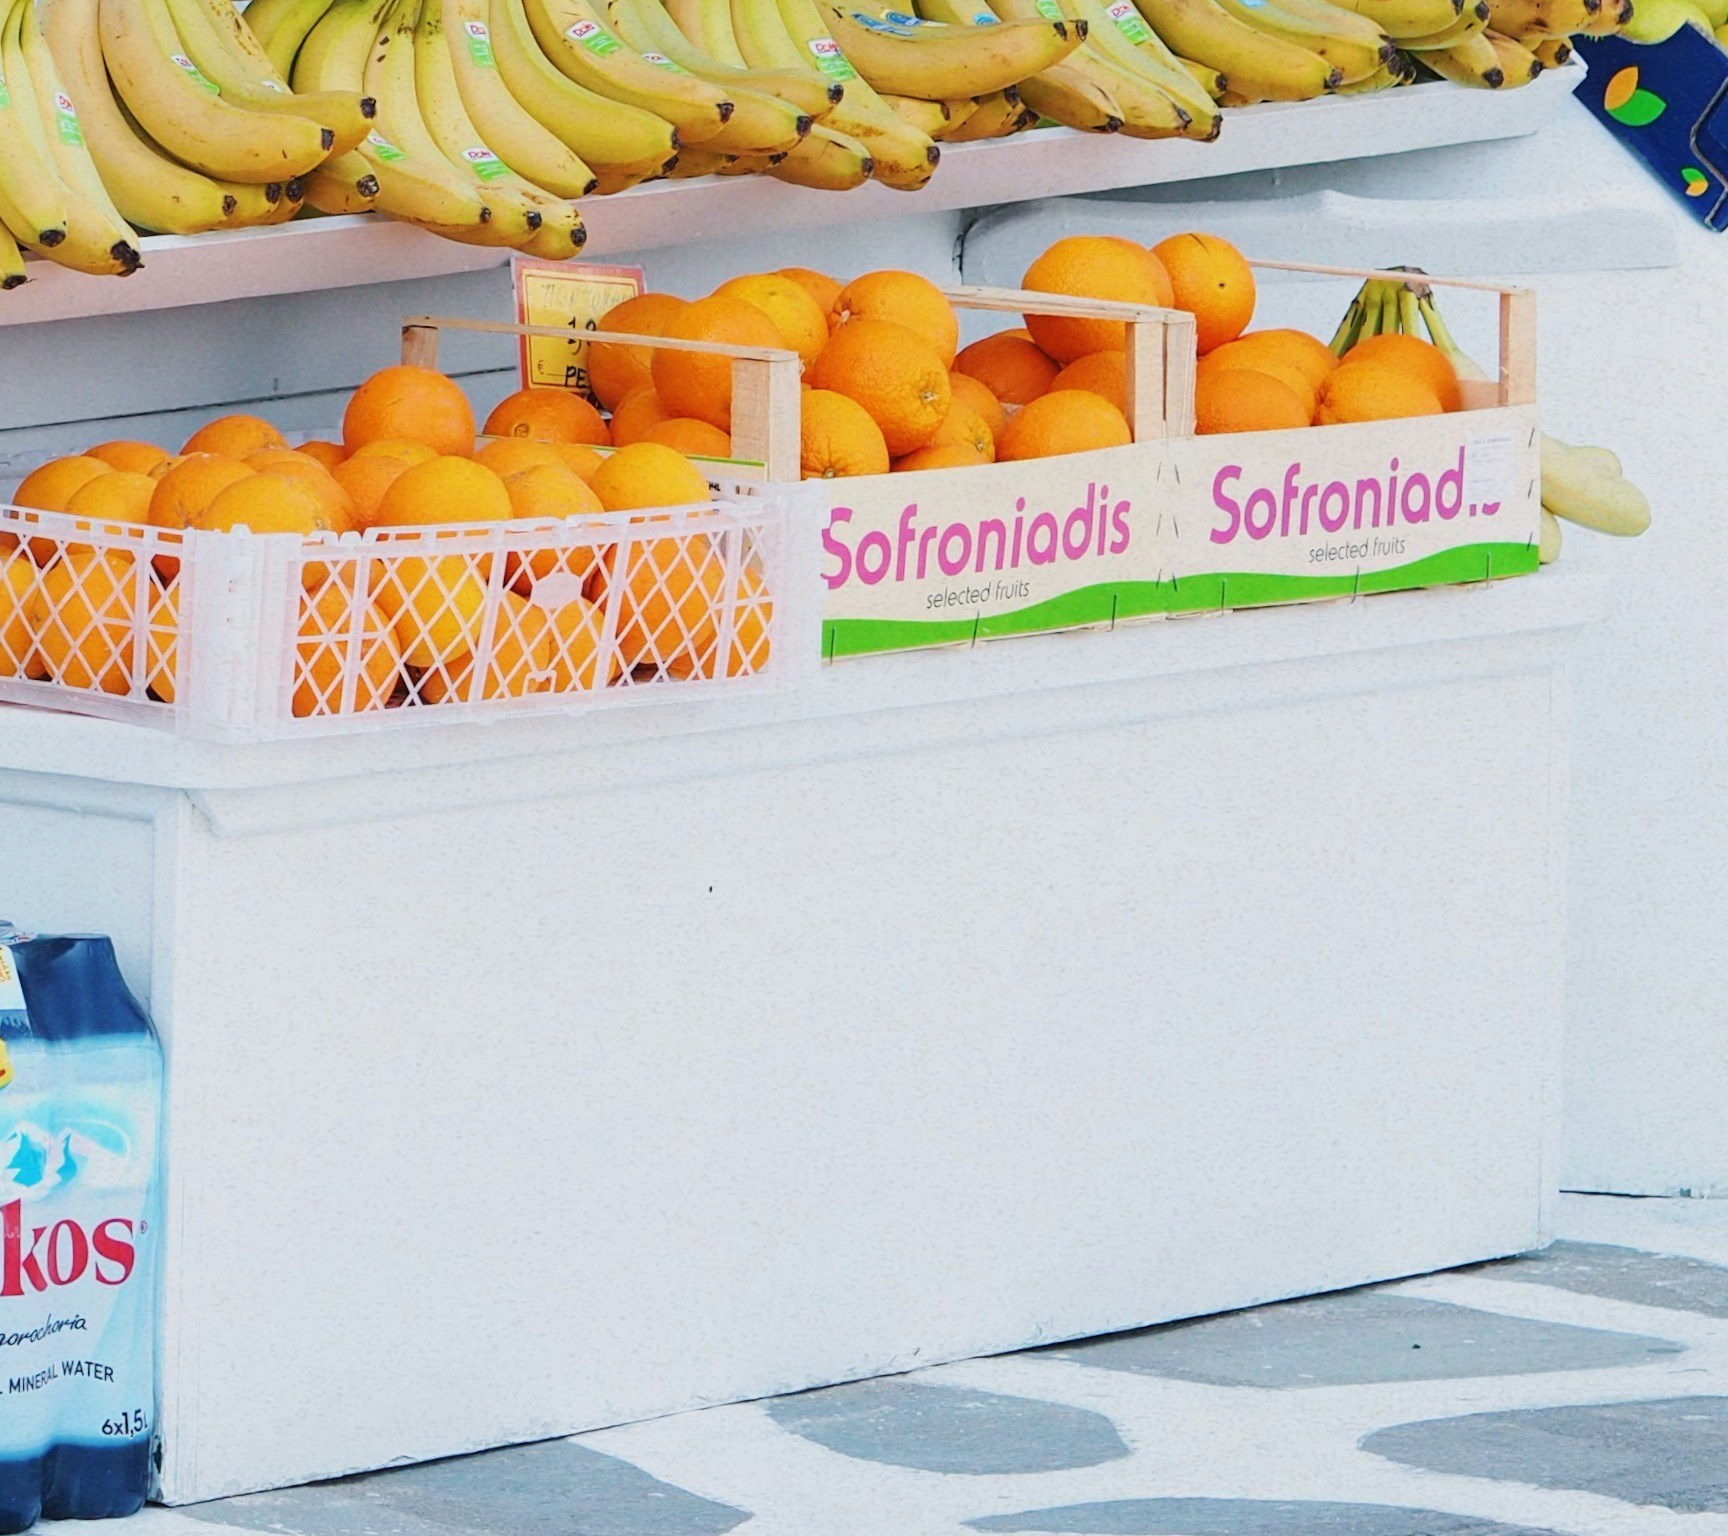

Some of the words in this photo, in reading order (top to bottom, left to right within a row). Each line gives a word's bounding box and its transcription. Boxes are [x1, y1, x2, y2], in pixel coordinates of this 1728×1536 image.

[564, 365, 588, 389] PE
[1210, 445, 1501, 548] Sofroniad
[820, 482, 1132, 590] Sofroniadis
[1309, 538, 1369, 563] selected
[1373, 536, 1406, 556] fruits
[927, 583, 990, 609] selected
[995, 579, 1031, 601] fruits
[8, 1366, 58, 1394] MINERAL
[62, 1359, 115, 1384] WATER
